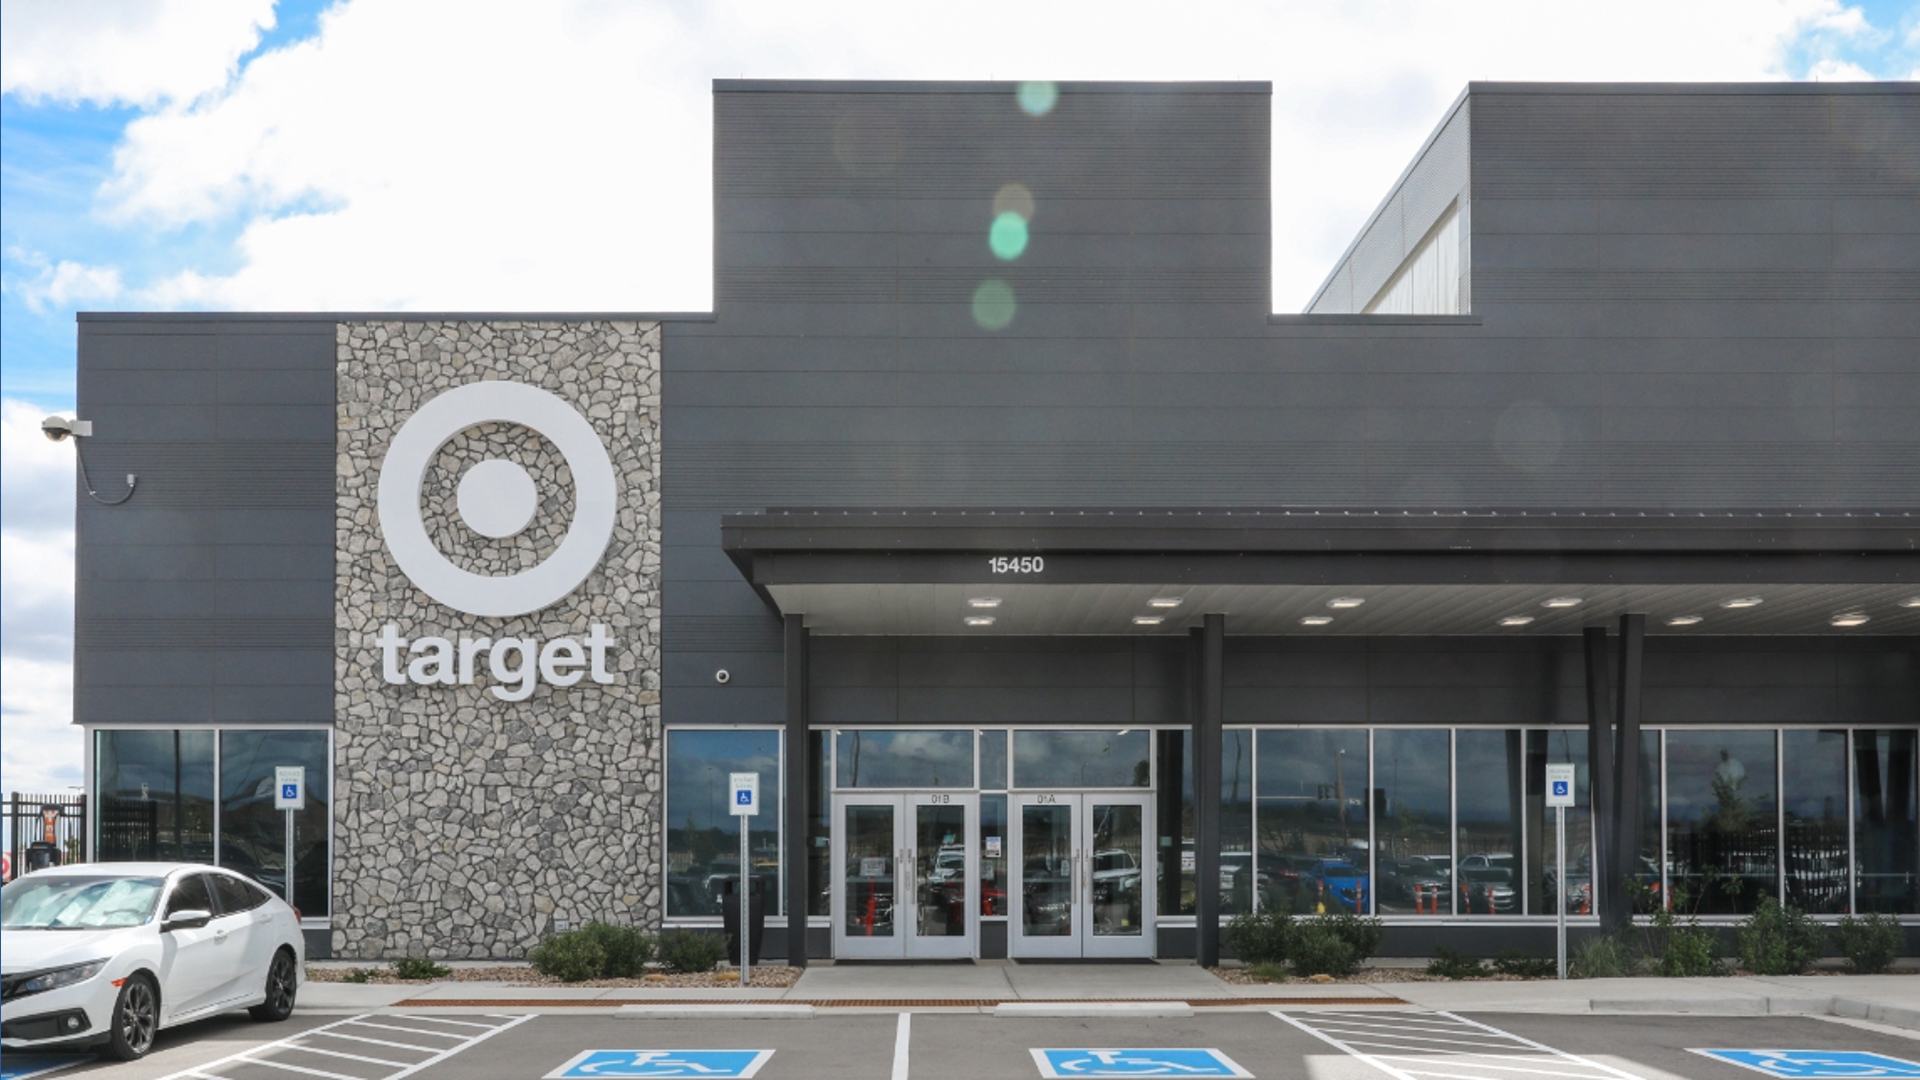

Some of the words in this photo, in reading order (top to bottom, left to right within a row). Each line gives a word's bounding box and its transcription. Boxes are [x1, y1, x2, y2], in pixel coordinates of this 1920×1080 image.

[988, 556, 1044, 573] 15450
[375, 623, 614, 702] target
[931, 794, 950, 804] 01B
[1037, 794, 1057, 804] 01A
